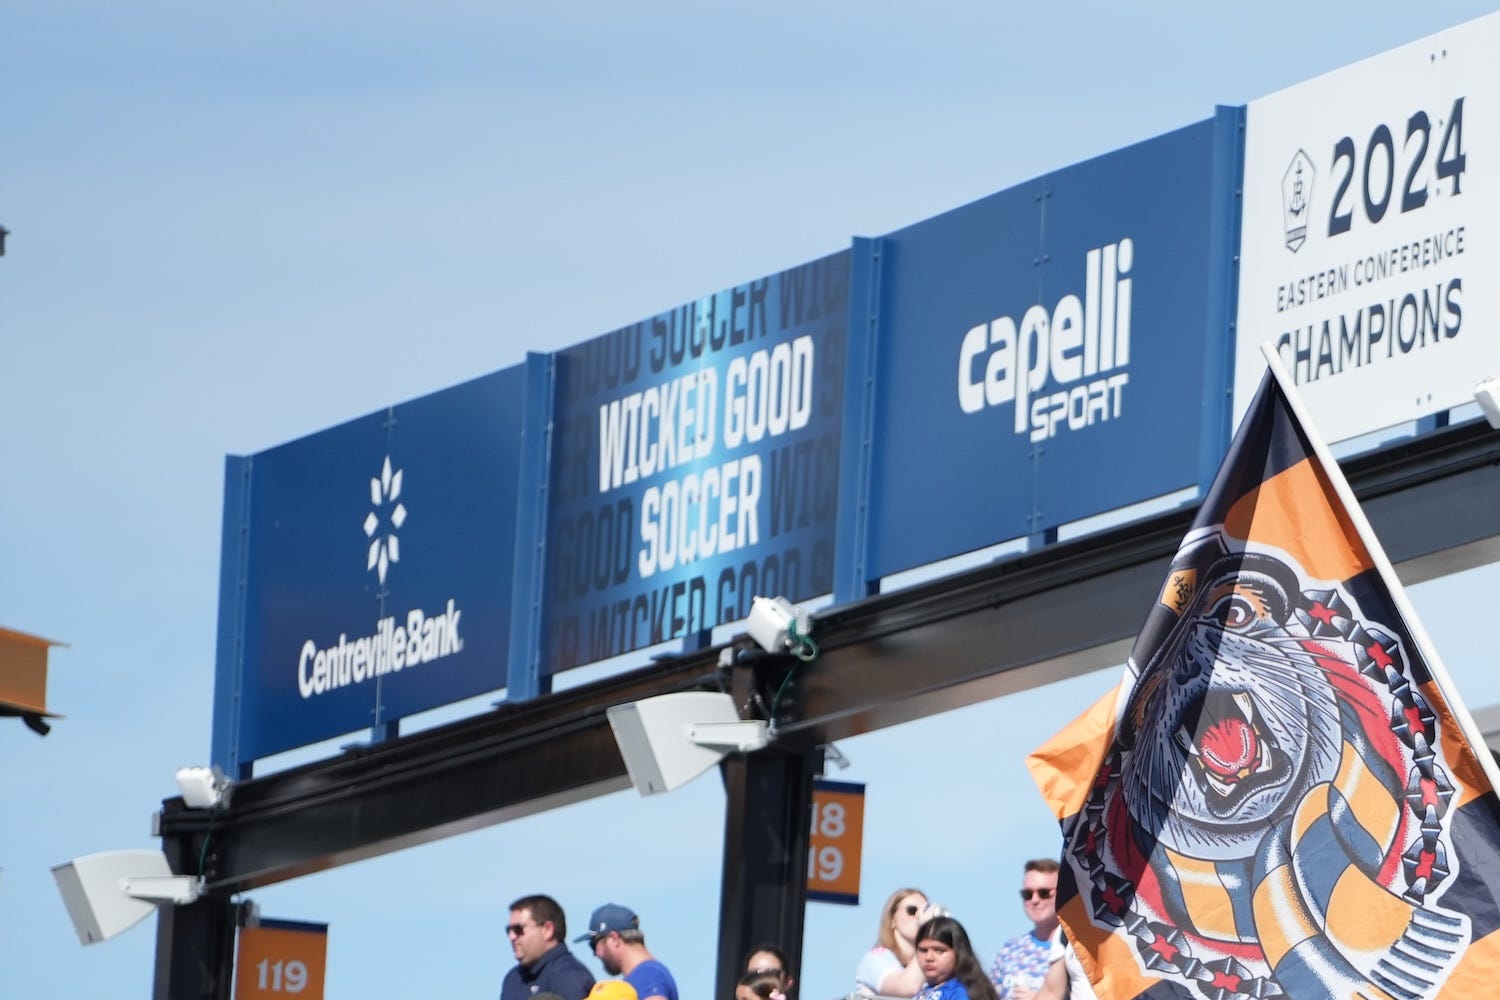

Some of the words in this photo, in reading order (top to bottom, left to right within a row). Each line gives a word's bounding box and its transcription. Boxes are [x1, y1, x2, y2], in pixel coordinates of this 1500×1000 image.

[1328, 96, 1467, 239] 2024
[1277, 263, 1349, 313] EASTERN
[1354, 226, 1466, 288] CONFERENCE
[957, 237, 1134, 435] capelli
[1277, 277, 1464, 387] CHAMPIONS
[599, 366, 719, 494] WICKED
[722, 334, 814, 450] GOOD
[1030, 374, 1129, 443] SPORT
[638, 453, 763, 579] SOCCER
[256, 958, 308, 992] 119
